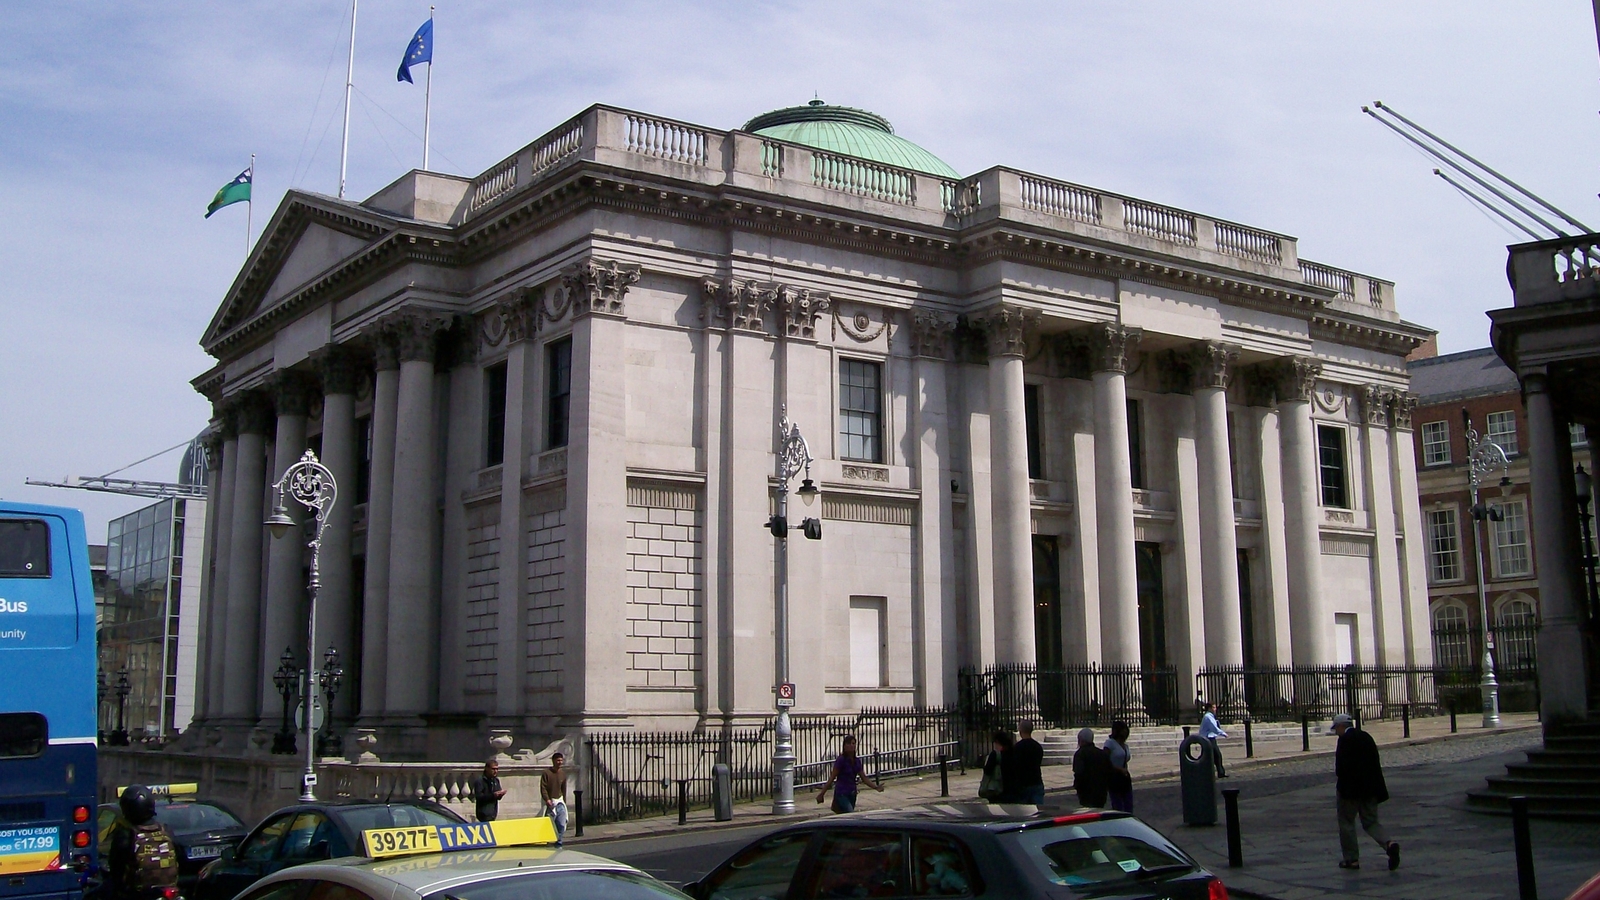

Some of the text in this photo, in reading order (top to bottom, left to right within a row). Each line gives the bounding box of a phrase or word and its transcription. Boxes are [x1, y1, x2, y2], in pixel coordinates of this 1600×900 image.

[0, 598, 28, 613] Bus
[0, 628, 26, 641] unity
[371, 824, 493, 852] 39277 TAXI
